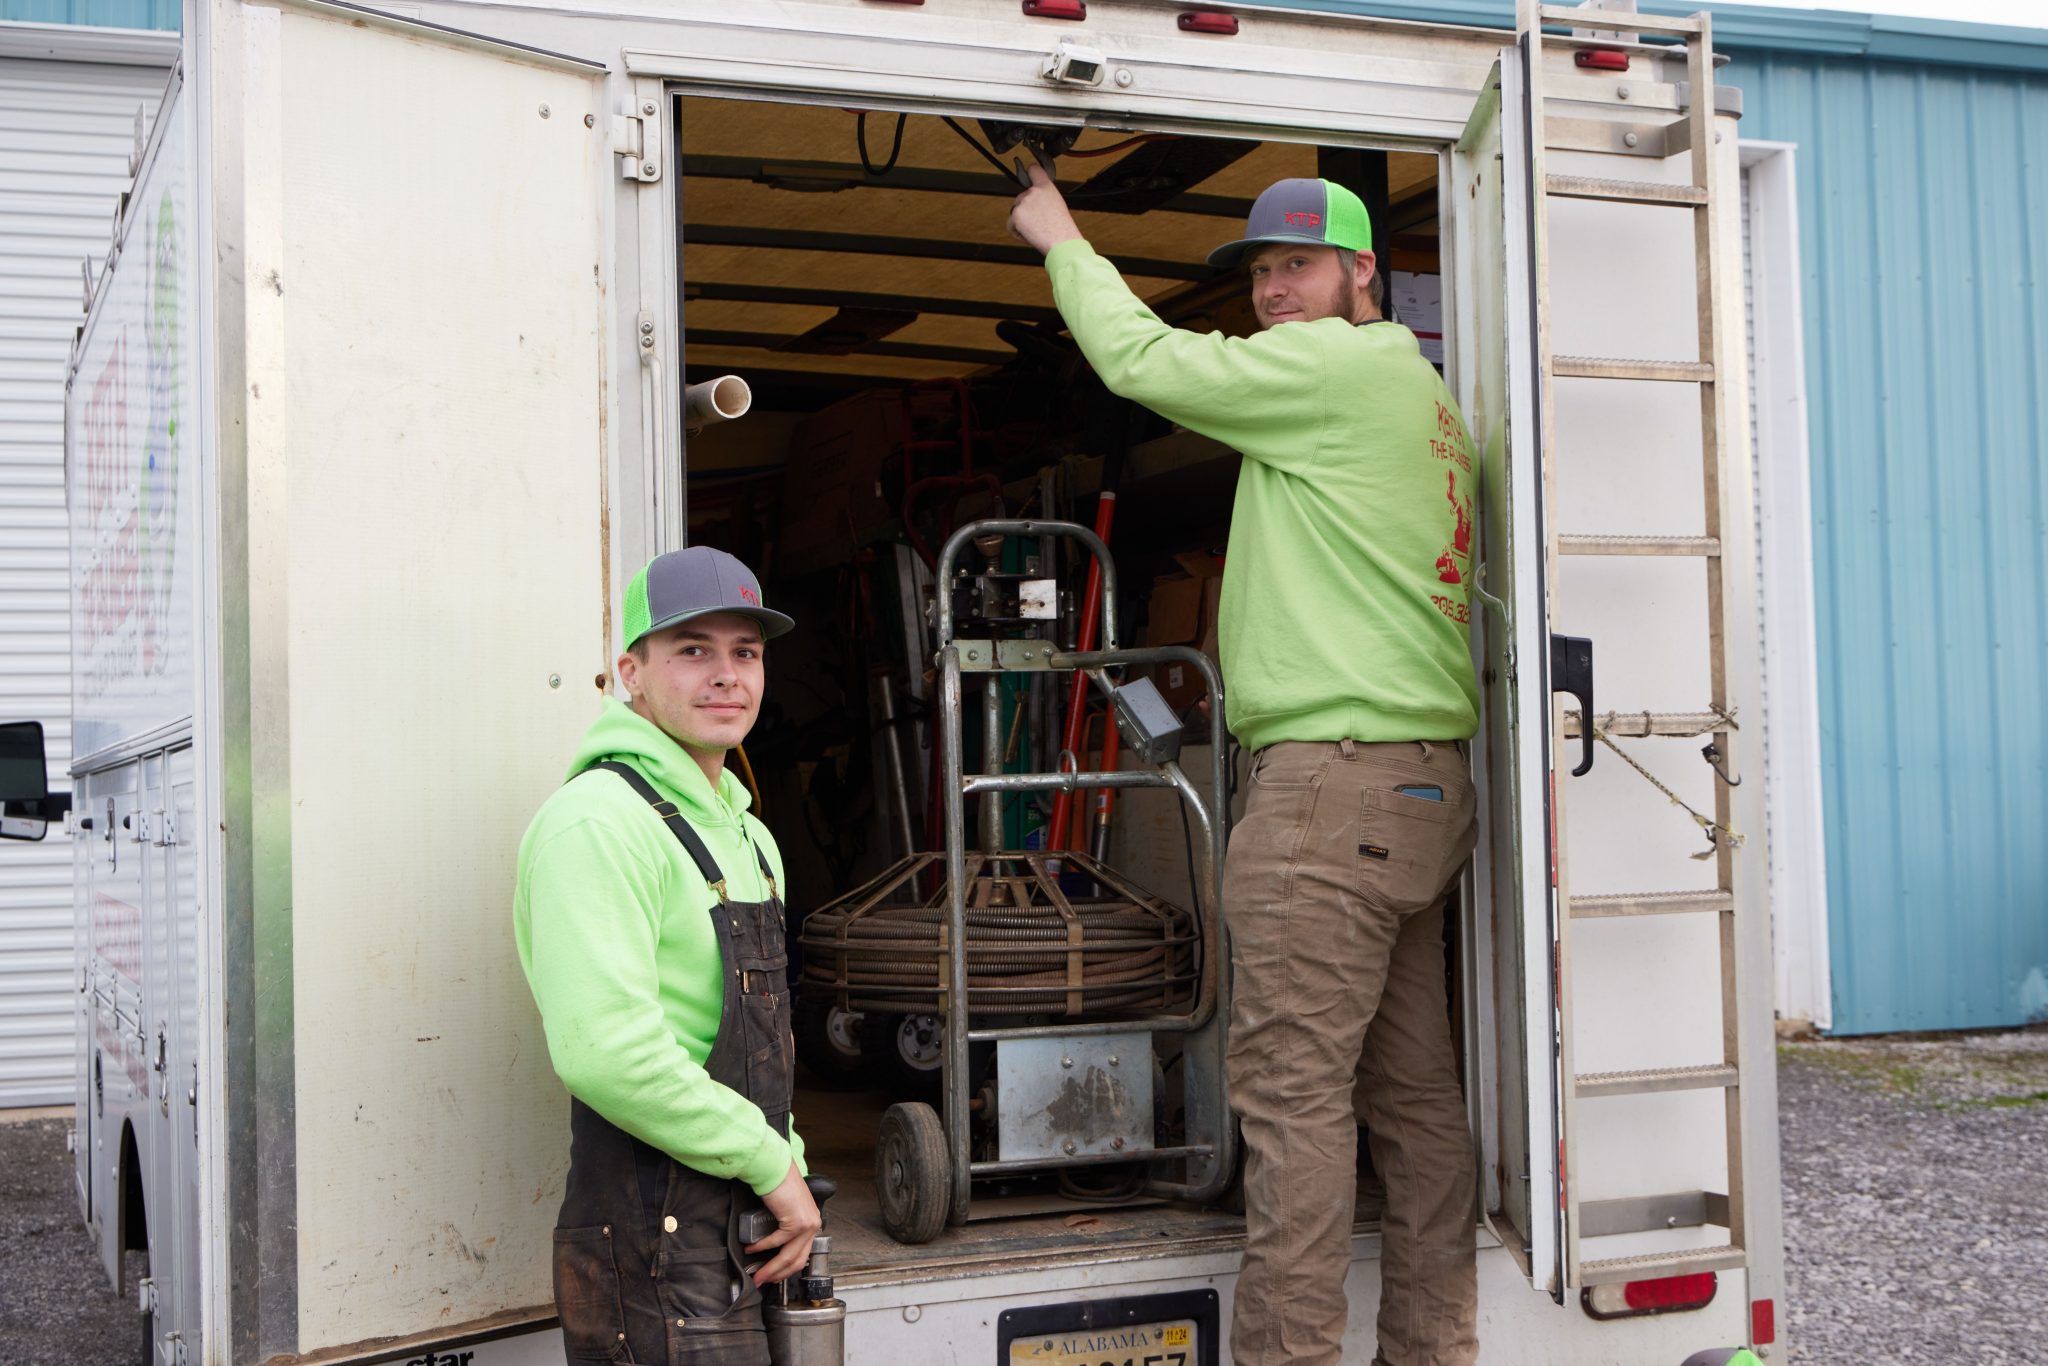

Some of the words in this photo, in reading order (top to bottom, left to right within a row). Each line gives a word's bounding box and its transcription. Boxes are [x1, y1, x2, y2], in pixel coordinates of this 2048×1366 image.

[1284, 211, 1321, 229] KTP
[1429, 439, 1448, 460] THE
[1058, 1331, 1149, 1356] ALABAMA
